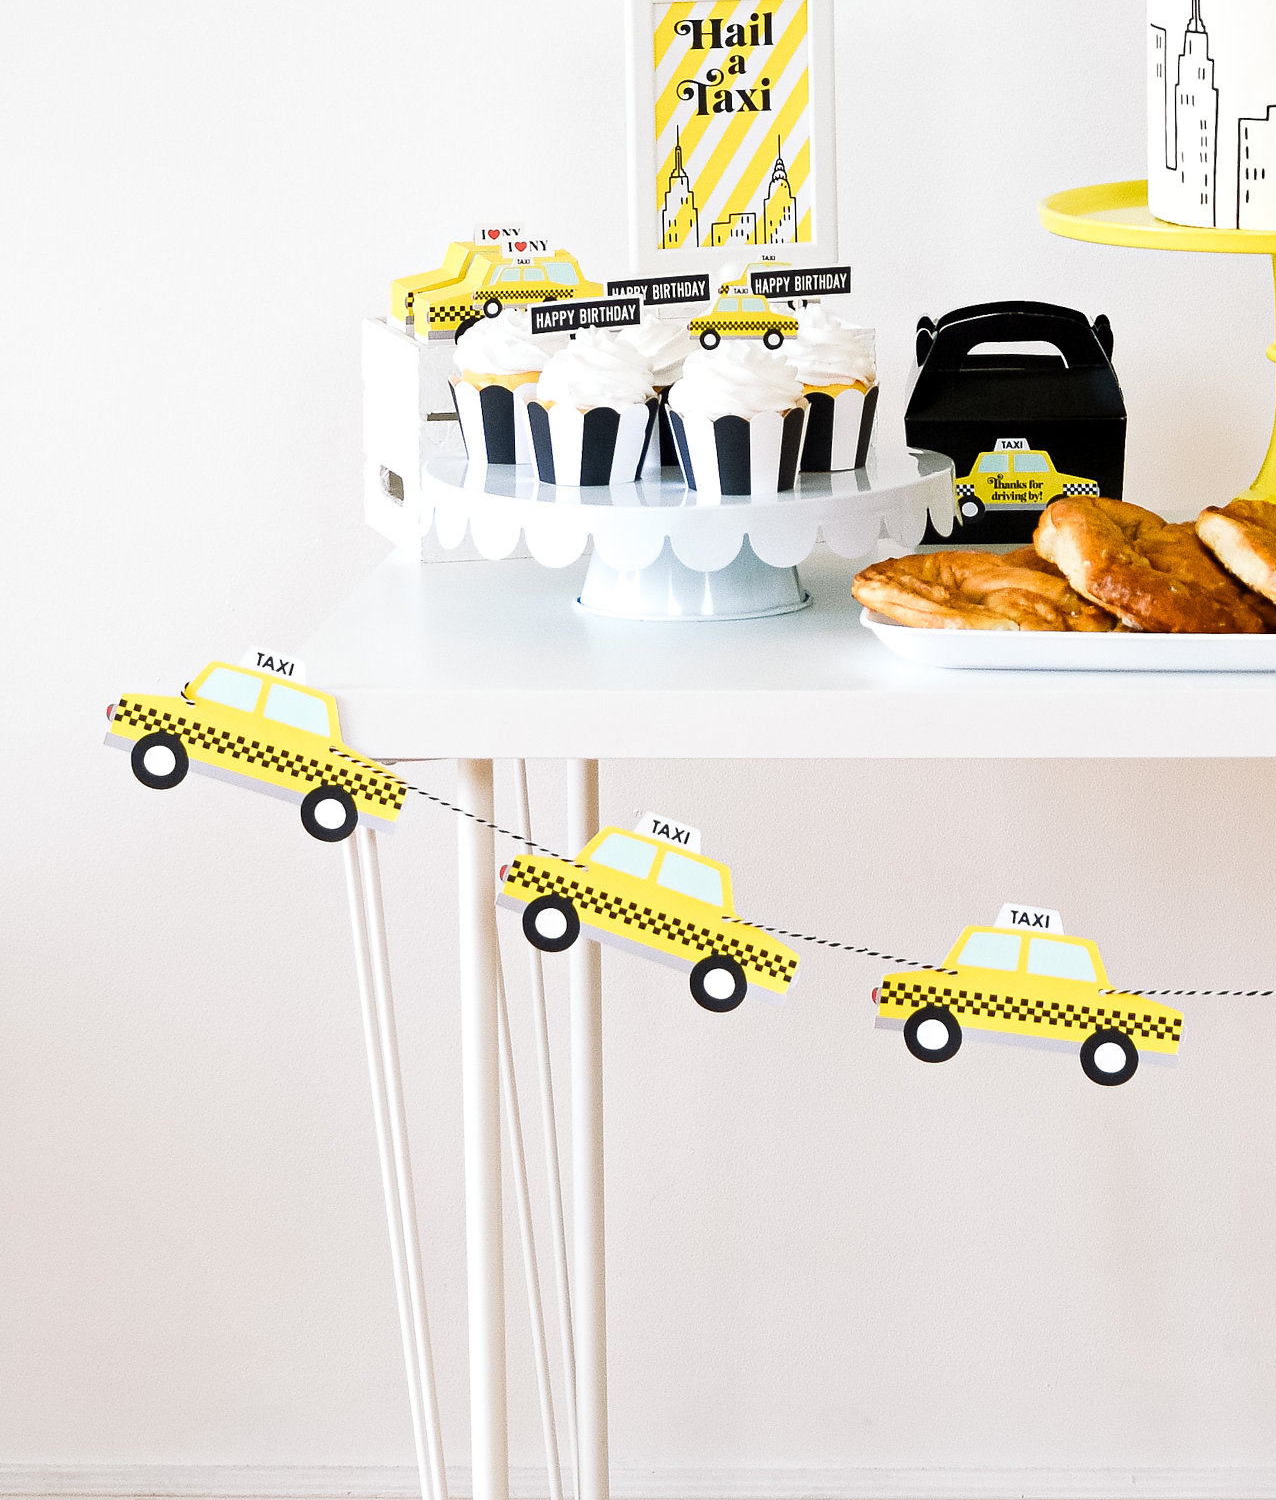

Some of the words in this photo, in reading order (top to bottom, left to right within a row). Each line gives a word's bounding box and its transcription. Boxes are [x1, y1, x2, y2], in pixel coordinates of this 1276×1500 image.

[674, 12, 774, 49] Hail
[728, 54, 747, 75] a
[676, 68, 772, 116] Taxi
[508, 241, 513, 252] I
[529, 240, 549, 251] NY
[652, 280, 706, 300] BIRTHDAY
[755, 276, 790, 294] HAPPY
[794, 273, 847, 292] BIRTHDAY
[536, 309, 575, 329] HAPPY
[579, 304, 636, 324] BIRTHDAY
[1001, 441, 1023, 449] TAXI
[987, 474, 1027, 489] Thanks
[1029, 479, 1044, 489] for
[992, 491, 1027, 503] driving
[1028, 491, 1043, 503] by!
[257, 652, 295, 676] TAXI
[652, 820, 690, 844] TAXI
[1010, 910, 1050, 928] TAXI
